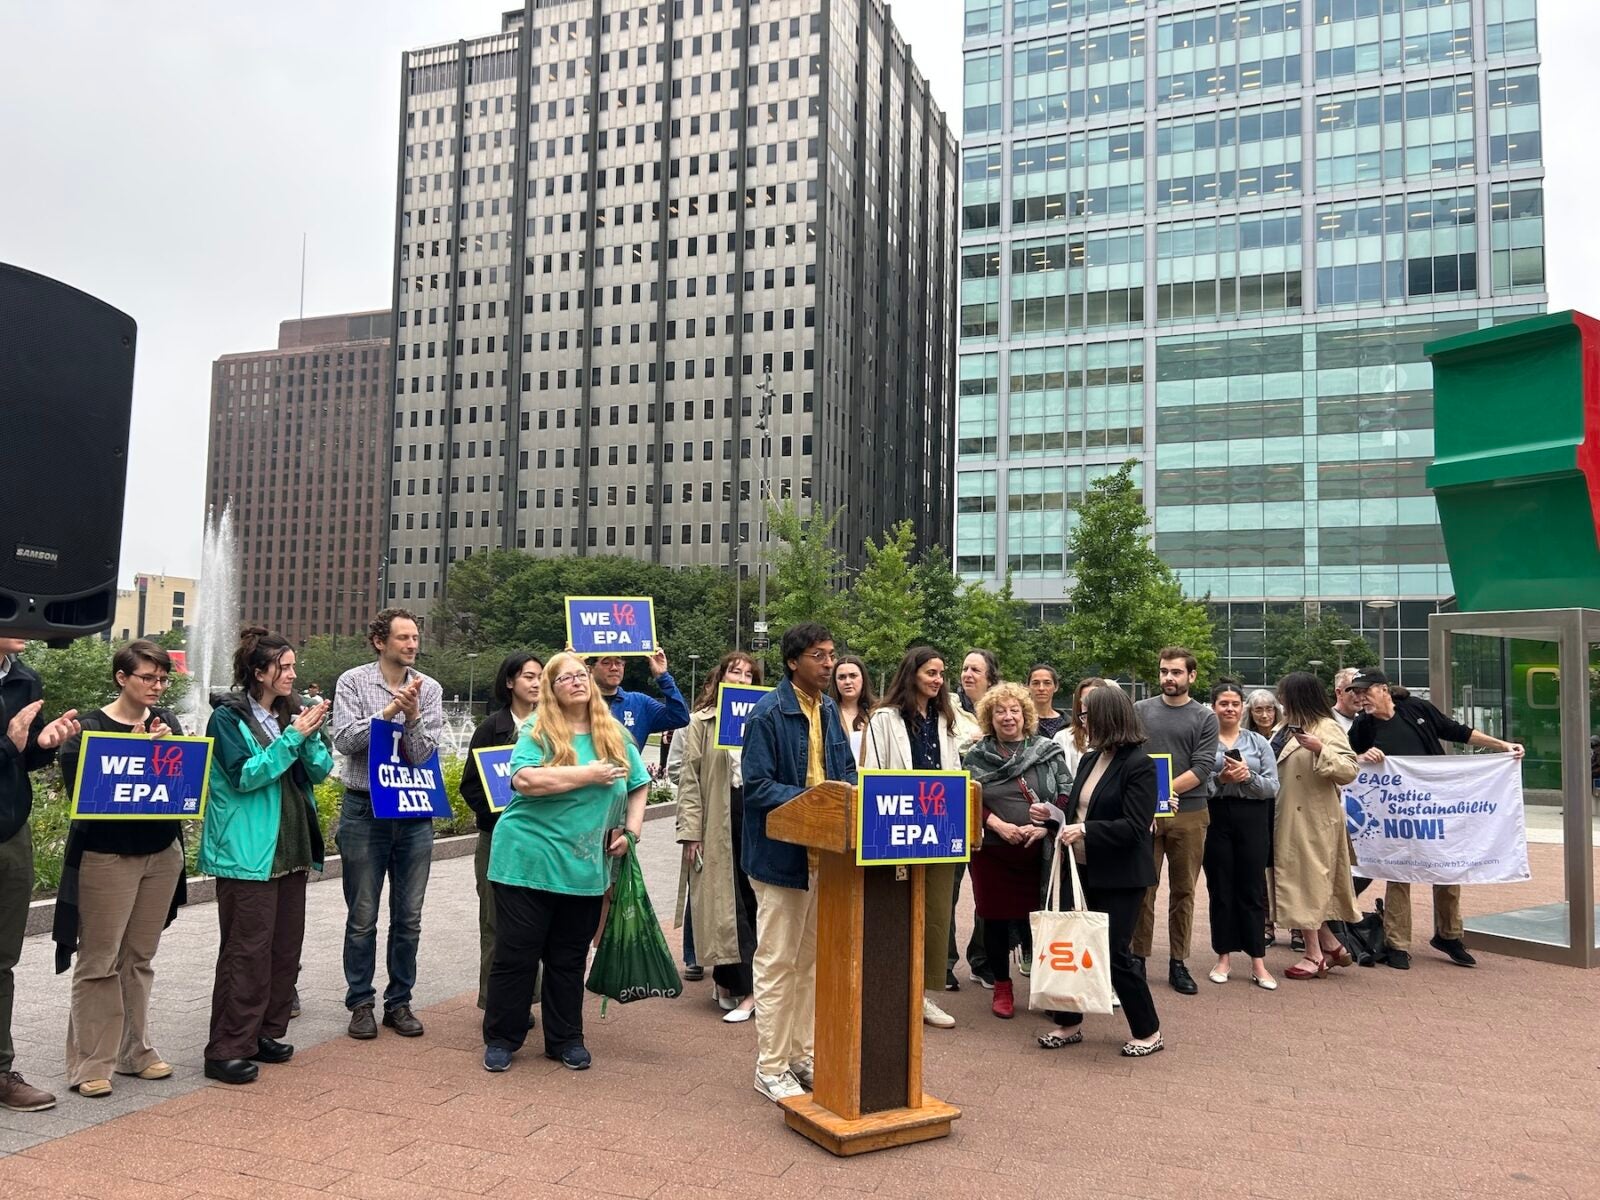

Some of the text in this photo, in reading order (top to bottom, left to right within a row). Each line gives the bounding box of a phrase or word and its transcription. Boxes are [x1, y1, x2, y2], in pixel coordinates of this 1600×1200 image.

[16, 548, 58, 561] SAMSON
[579, 612, 611, 626] WE
[593, 630, 632, 645] EPA
[390, 731, 402, 763] I
[100, 755, 146, 775] WE
[378, 763, 436, 790] CLEAN
[1357, 772, 1402, 786] EACE
[113, 783, 170, 803] EPA
[398, 790, 434, 812] AIR
[1380, 789, 1432, 803] Justice
[876, 795, 914, 815] WE
[1387, 801, 1498, 816] Sustainability
[891, 824, 939, 845] EPA
[1383, 818, 1445, 840] NOW!
[620, 982, 676, 1001] explore
